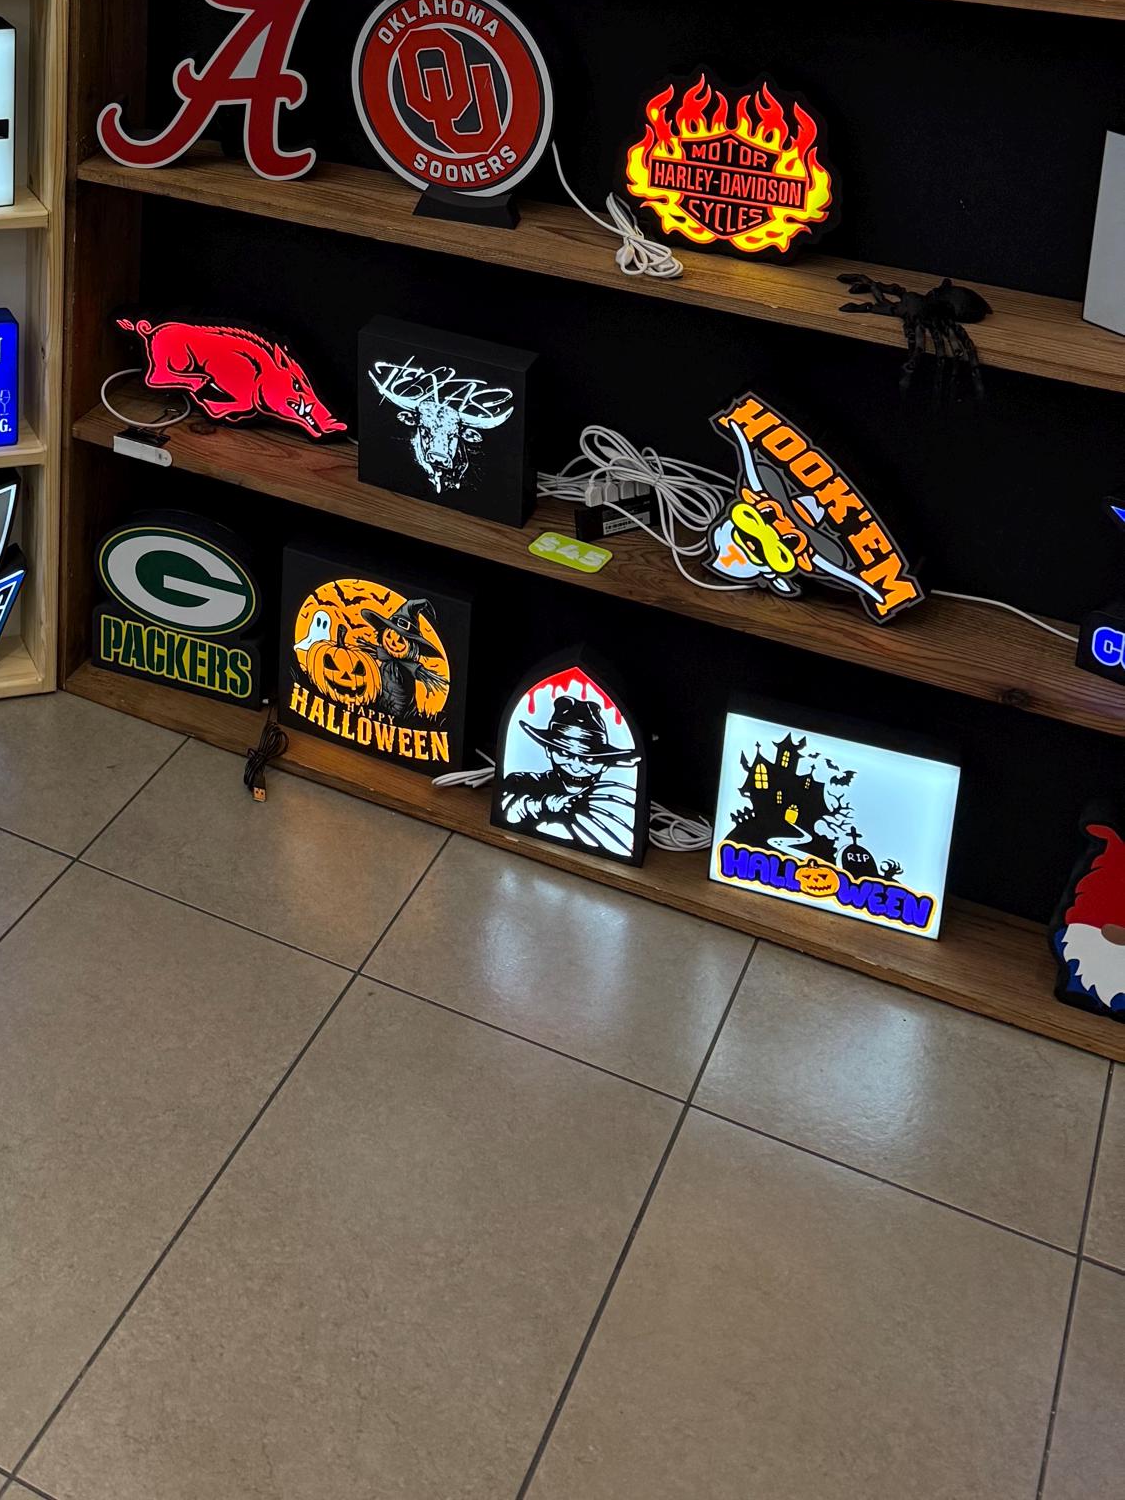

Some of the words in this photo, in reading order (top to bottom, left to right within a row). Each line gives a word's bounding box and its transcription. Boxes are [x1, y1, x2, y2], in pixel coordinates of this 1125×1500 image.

[413, 145, 518, 183] SOONERS
[691, 139, 768, 168] MOTOR
[654, 161, 802, 206] HARLEY-DAVIDSON
[688, 200, 764, 233] CYCLES
[535, 536, 607, 567] $45
[107, 535, 247, 627] G
[100, 614, 252, 699] PACKERS
[289, 682, 450, 763] HALLOWEEN
[347, 702, 396, 726] HAPPY
[847, 851, 870, 863] RIP
